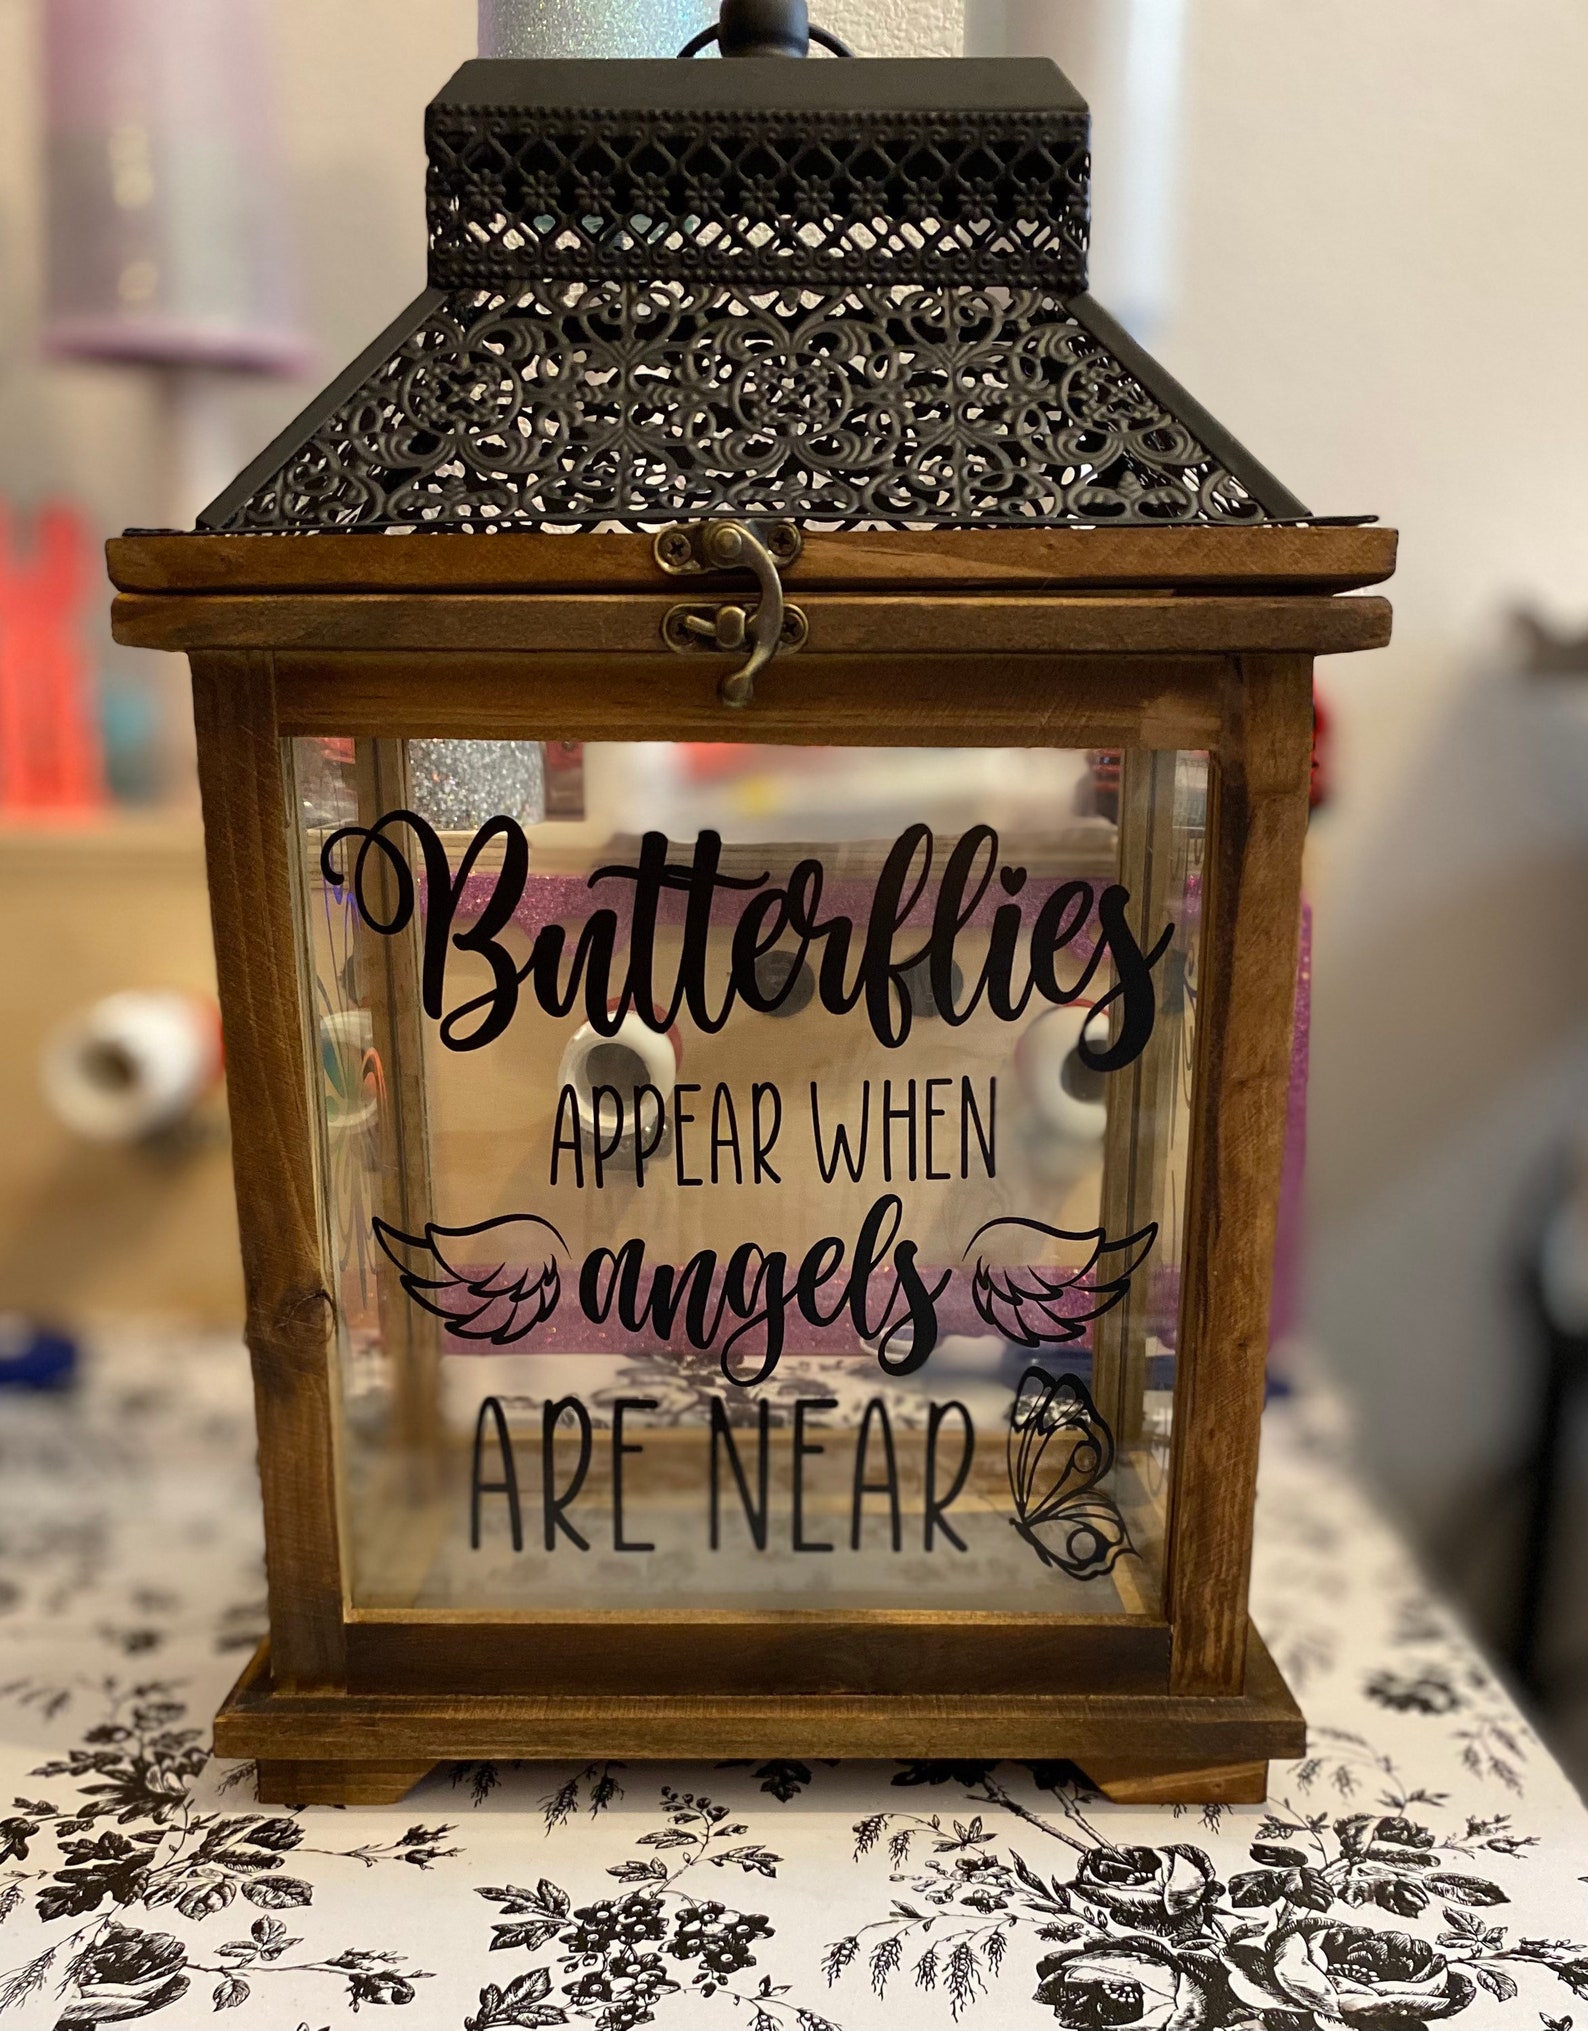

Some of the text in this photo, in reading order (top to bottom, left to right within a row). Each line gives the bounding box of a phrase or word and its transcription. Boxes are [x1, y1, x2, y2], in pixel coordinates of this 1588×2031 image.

[320, 809, 1176, 1072] Butterflies
[550, 1075, 997, 1188] APPEAR WHEN
[579, 1194, 953, 1387] angels
[470, 1395, 975, 1553] ARE NEAR
